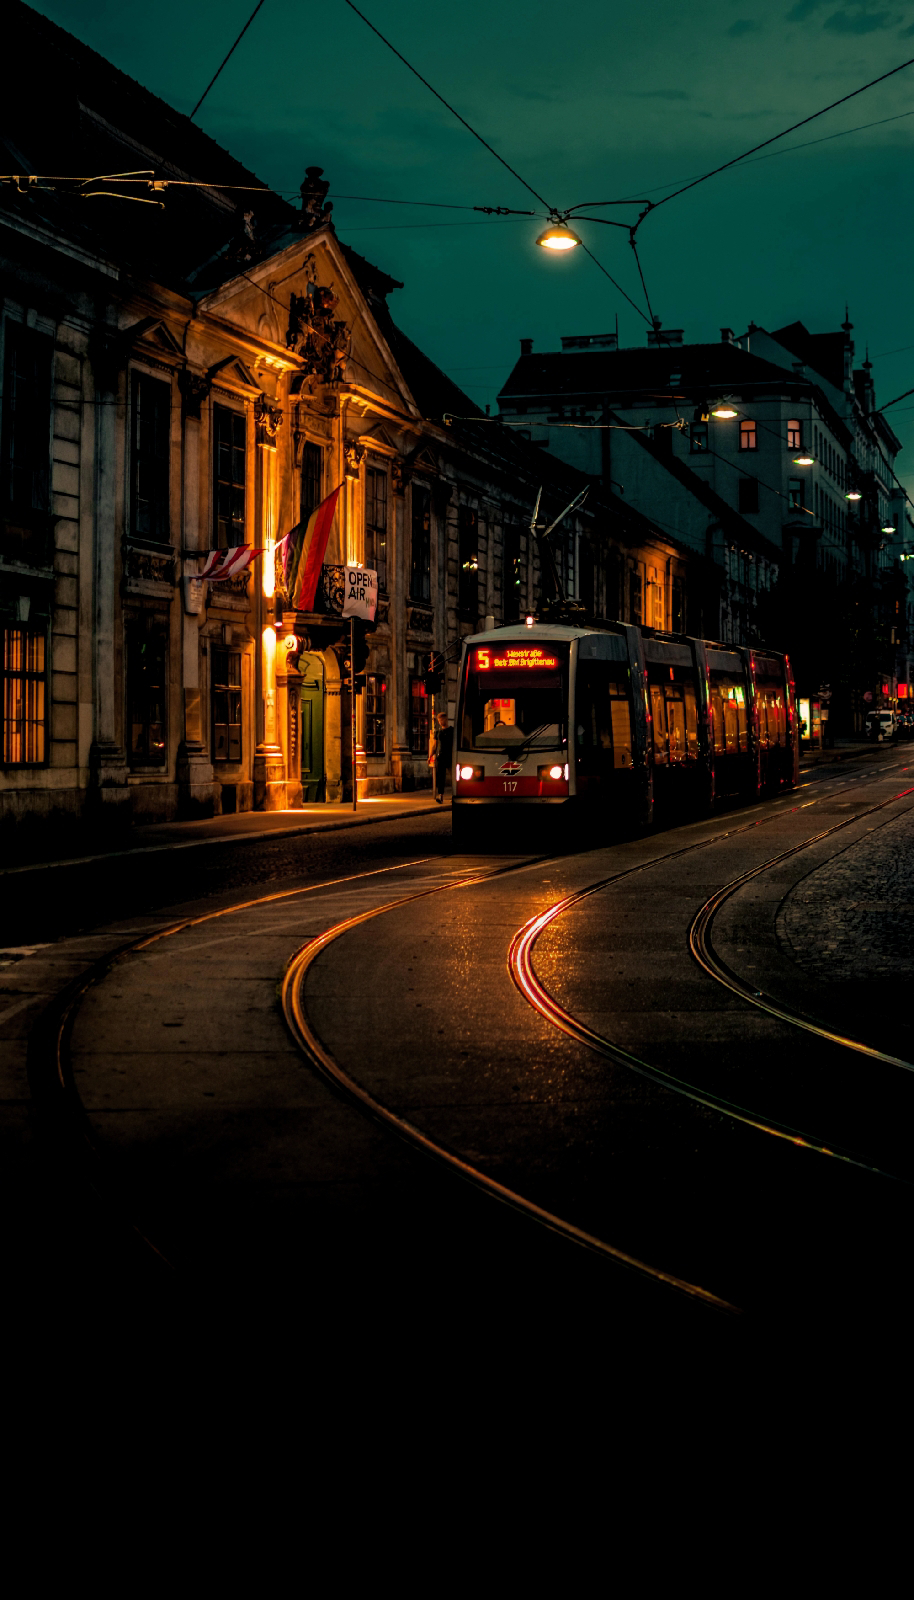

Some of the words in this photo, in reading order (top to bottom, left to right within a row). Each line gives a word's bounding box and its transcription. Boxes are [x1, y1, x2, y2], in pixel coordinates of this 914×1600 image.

[348, 571, 372, 587] OPEN
[347, 586, 366, 601] AIR
[477, 650, 490, 668] 5
[503, 781, 518, 792] 117
